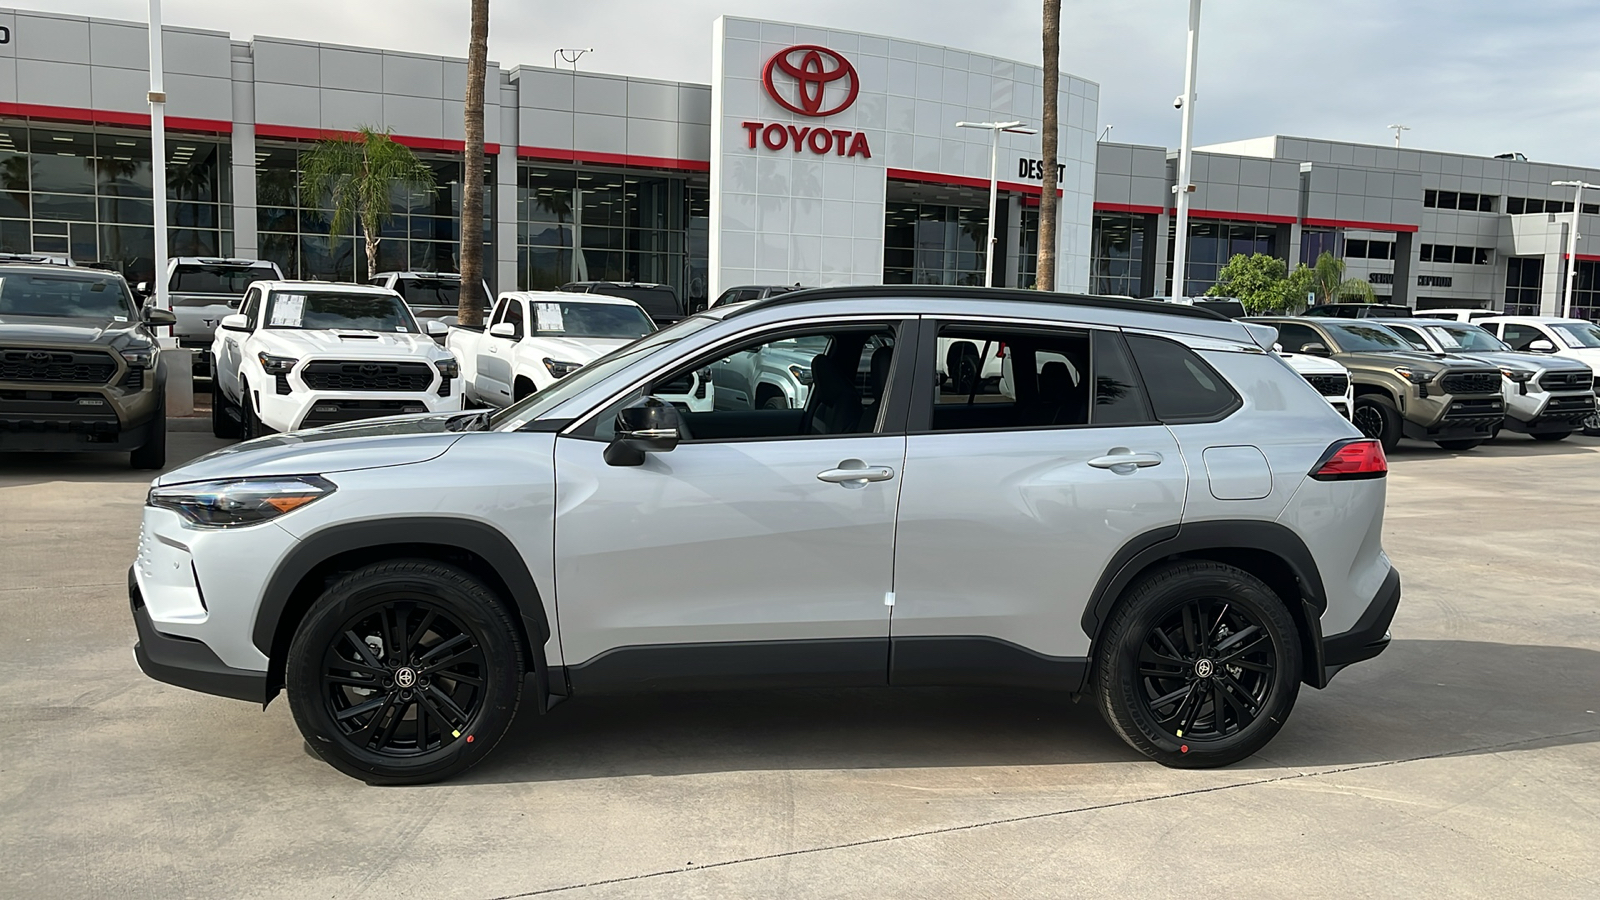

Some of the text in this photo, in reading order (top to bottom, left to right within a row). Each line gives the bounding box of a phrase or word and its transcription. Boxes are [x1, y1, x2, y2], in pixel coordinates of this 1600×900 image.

[742, 121, 871, 159] TOYOTA
[1019, 157, 1066, 184] DEST
[1368, 272, 1453, 288] SERV CEPTION
[1122, 677, 1161, 741] ASSURANCE
